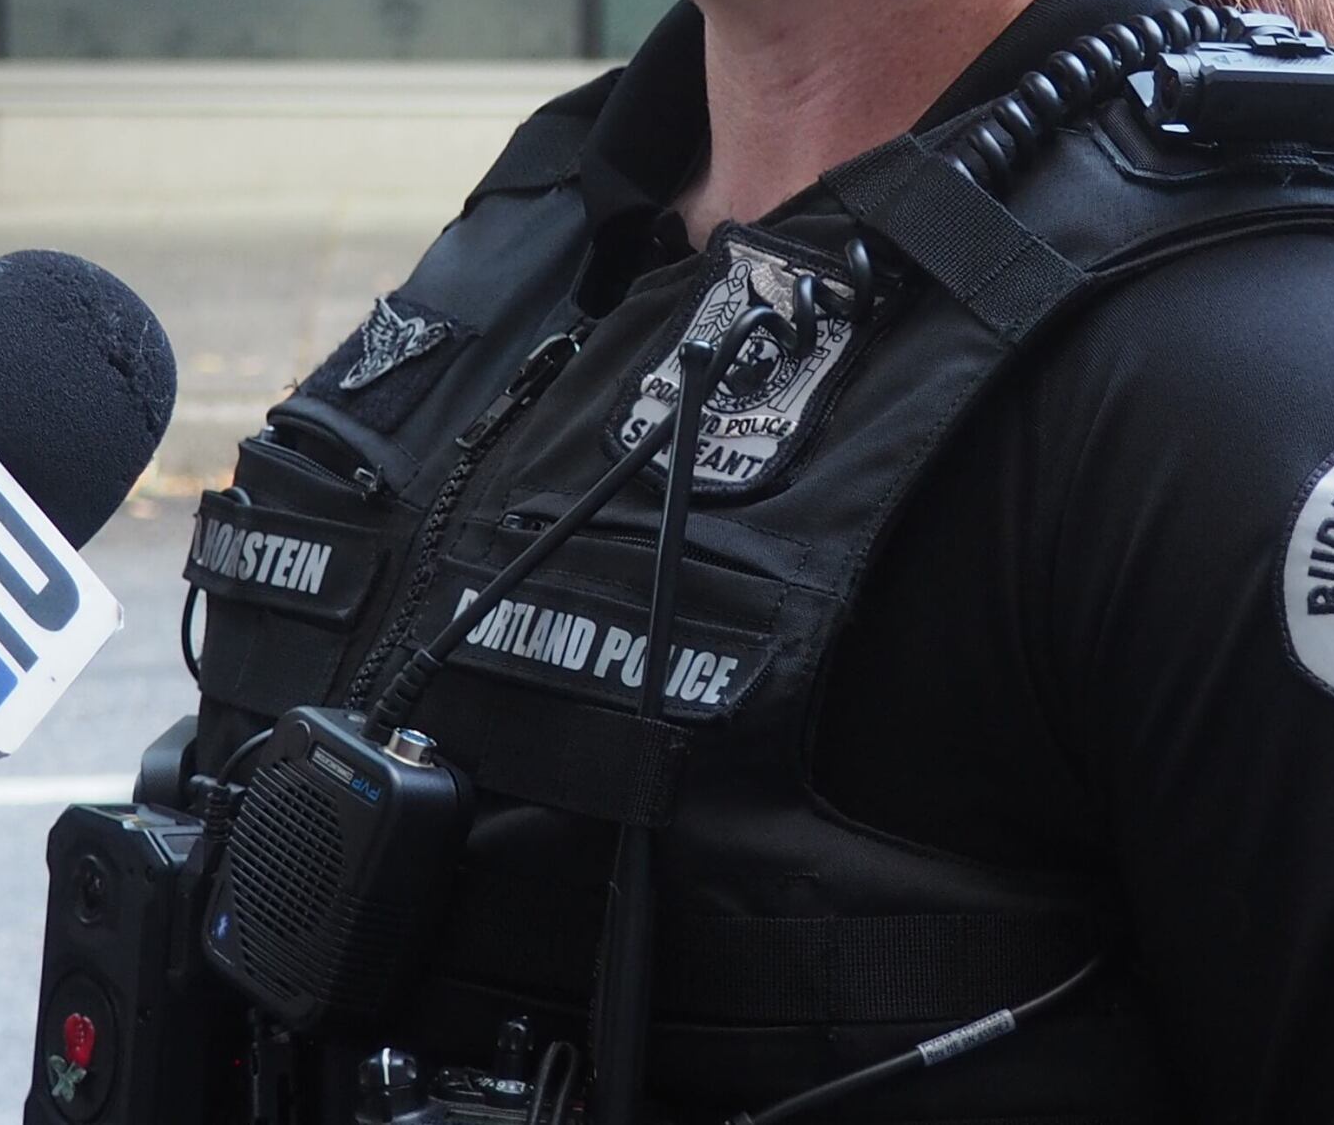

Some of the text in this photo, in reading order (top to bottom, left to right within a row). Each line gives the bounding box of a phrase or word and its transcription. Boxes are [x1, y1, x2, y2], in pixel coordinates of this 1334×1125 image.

[622, 418, 763, 479] SEANT
[725, 417, 792, 437] POLICE
[452, 588, 738, 704] PORTLAND POICE
